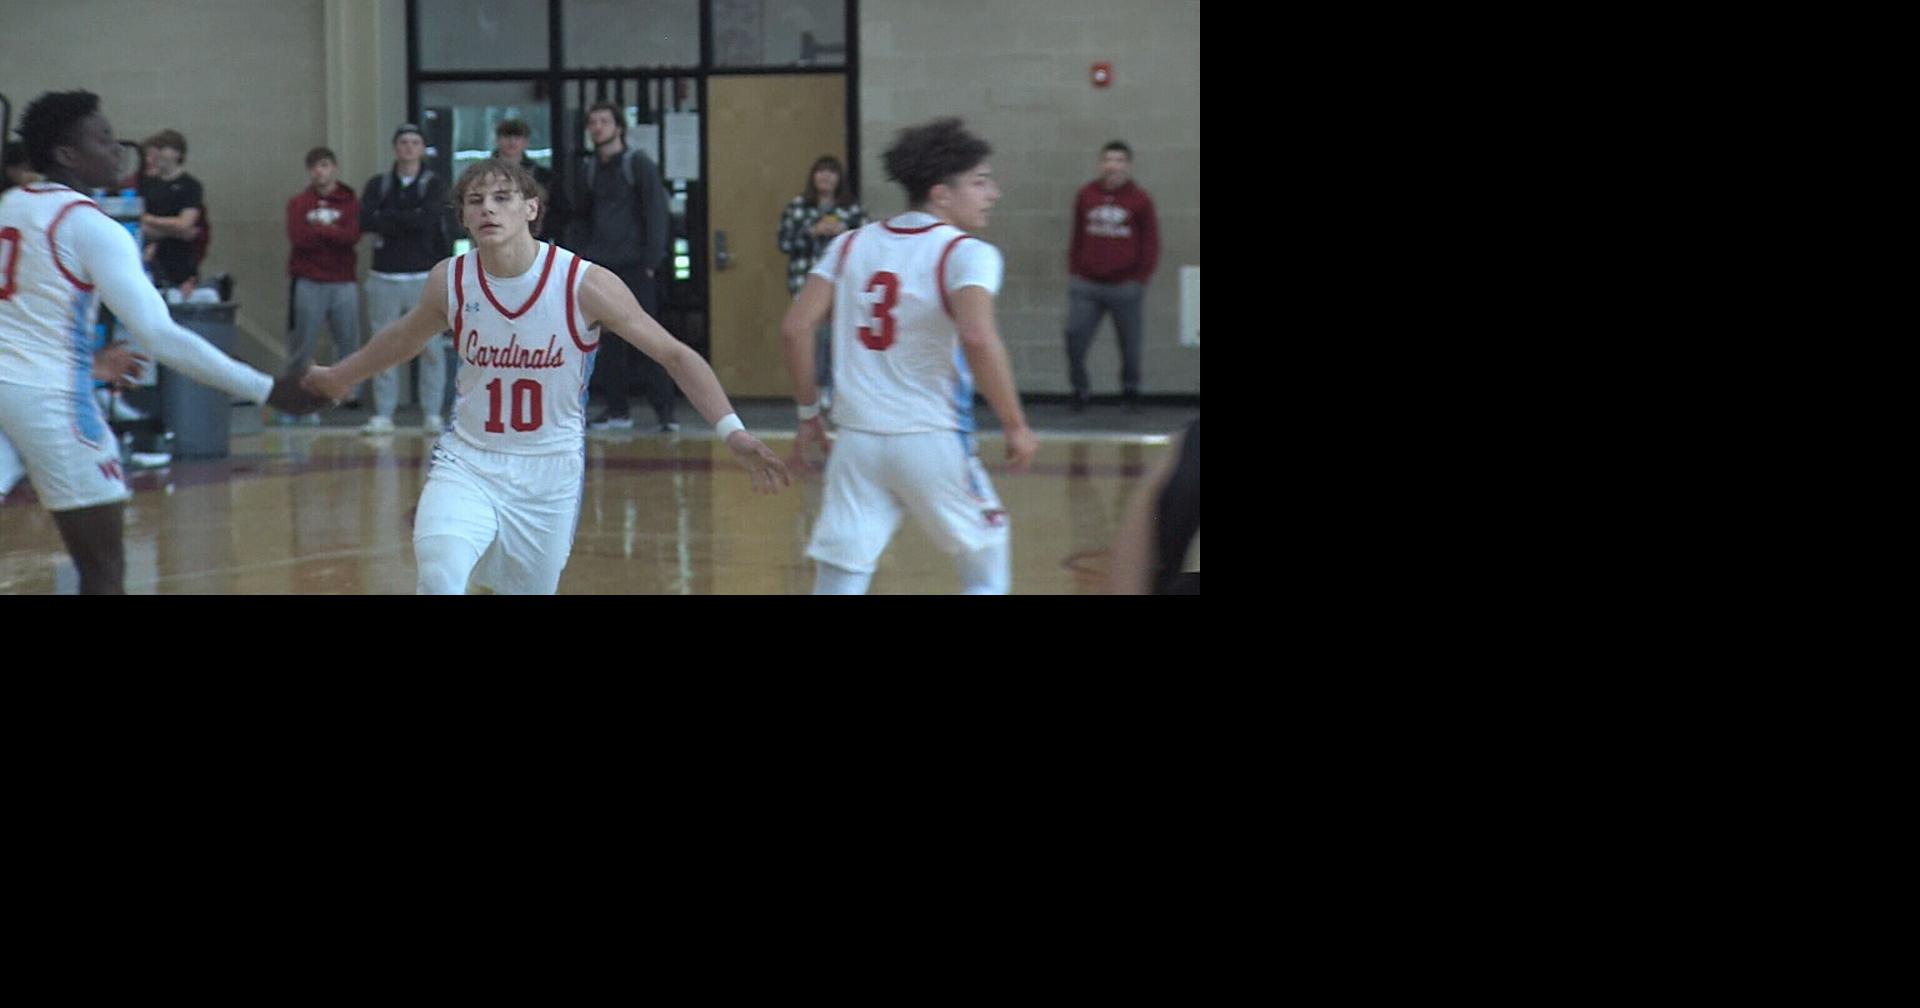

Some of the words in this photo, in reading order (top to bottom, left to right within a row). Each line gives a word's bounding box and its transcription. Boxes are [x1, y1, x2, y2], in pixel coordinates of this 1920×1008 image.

[857, 270, 900, 351] 3
[465, 329, 565, 369] Cardinals
[484, 377, 543, 433] 10
